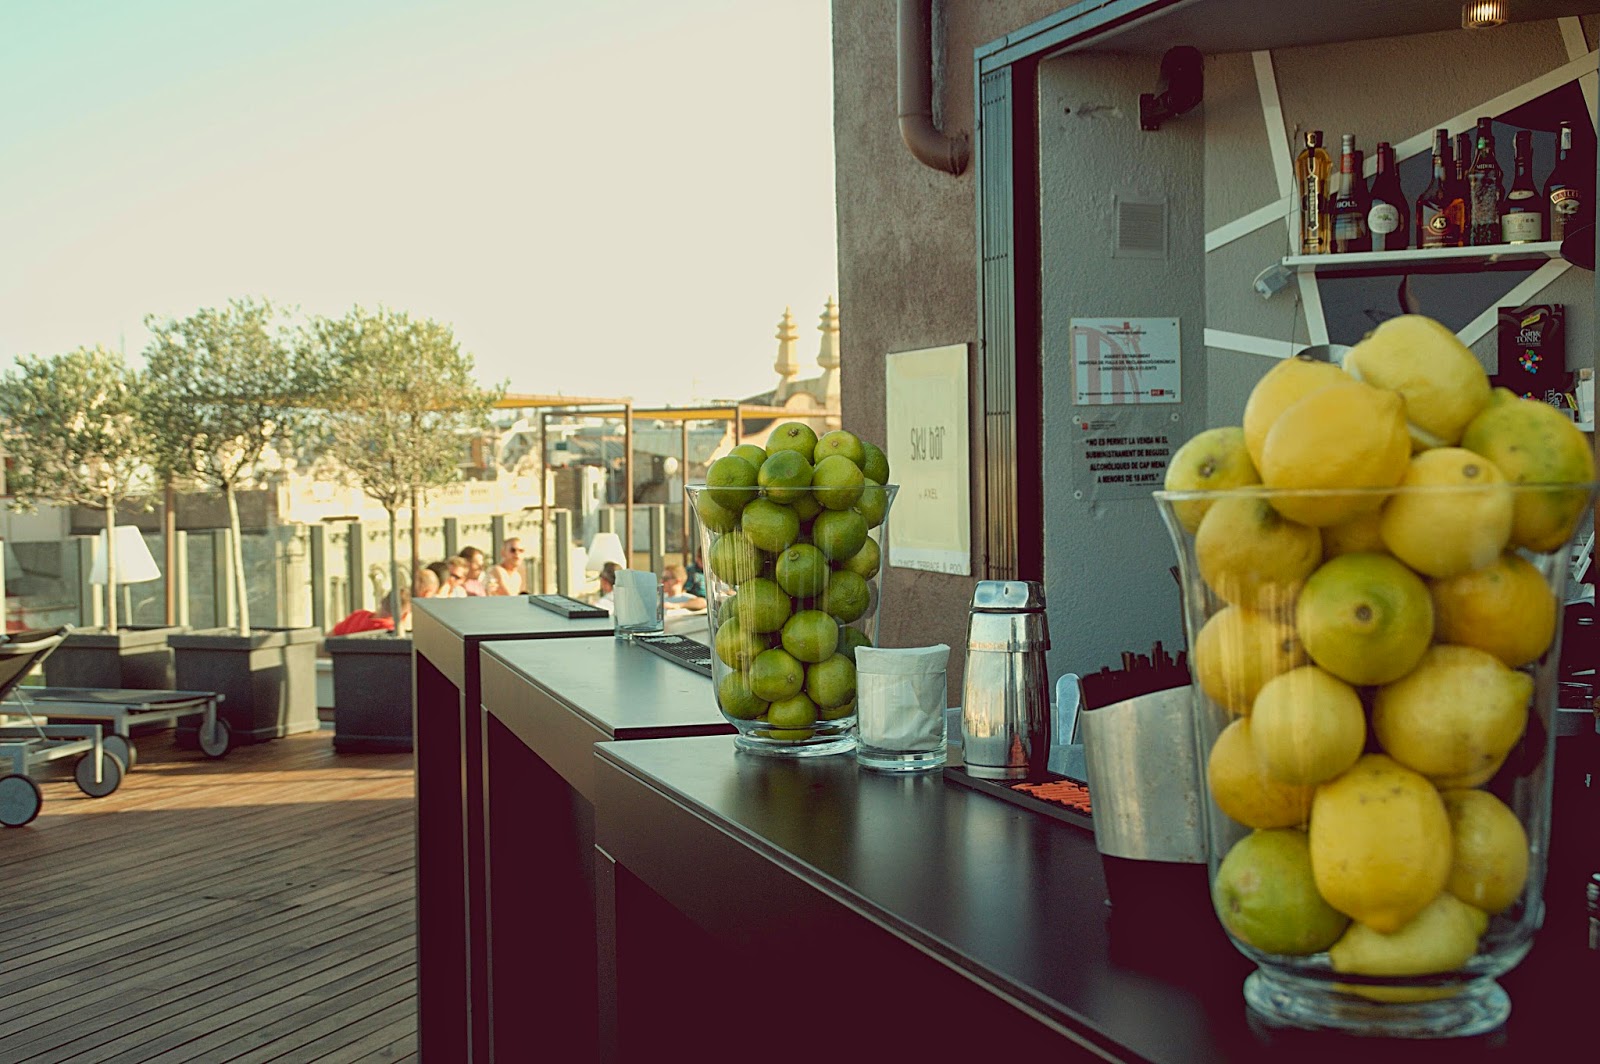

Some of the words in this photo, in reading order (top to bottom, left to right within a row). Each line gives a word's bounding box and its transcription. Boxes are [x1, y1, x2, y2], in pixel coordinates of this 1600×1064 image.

[1432, 217, 1447, 229] 43
[1106, 438, 1127, 446] PERMET
[1128, 437, 1135, 445] LA
[1137, 436, 1153, 444] VENDA
[1086, 449, 1136, 459] SUBMINISTRAMENT
[1137, 449, 1144, 457] DE
[1145, 448, 1169, 457] BEGUDES
[1103, 474, 1124, 483] MENORS
[1126, 474, 1132, 482] DE
